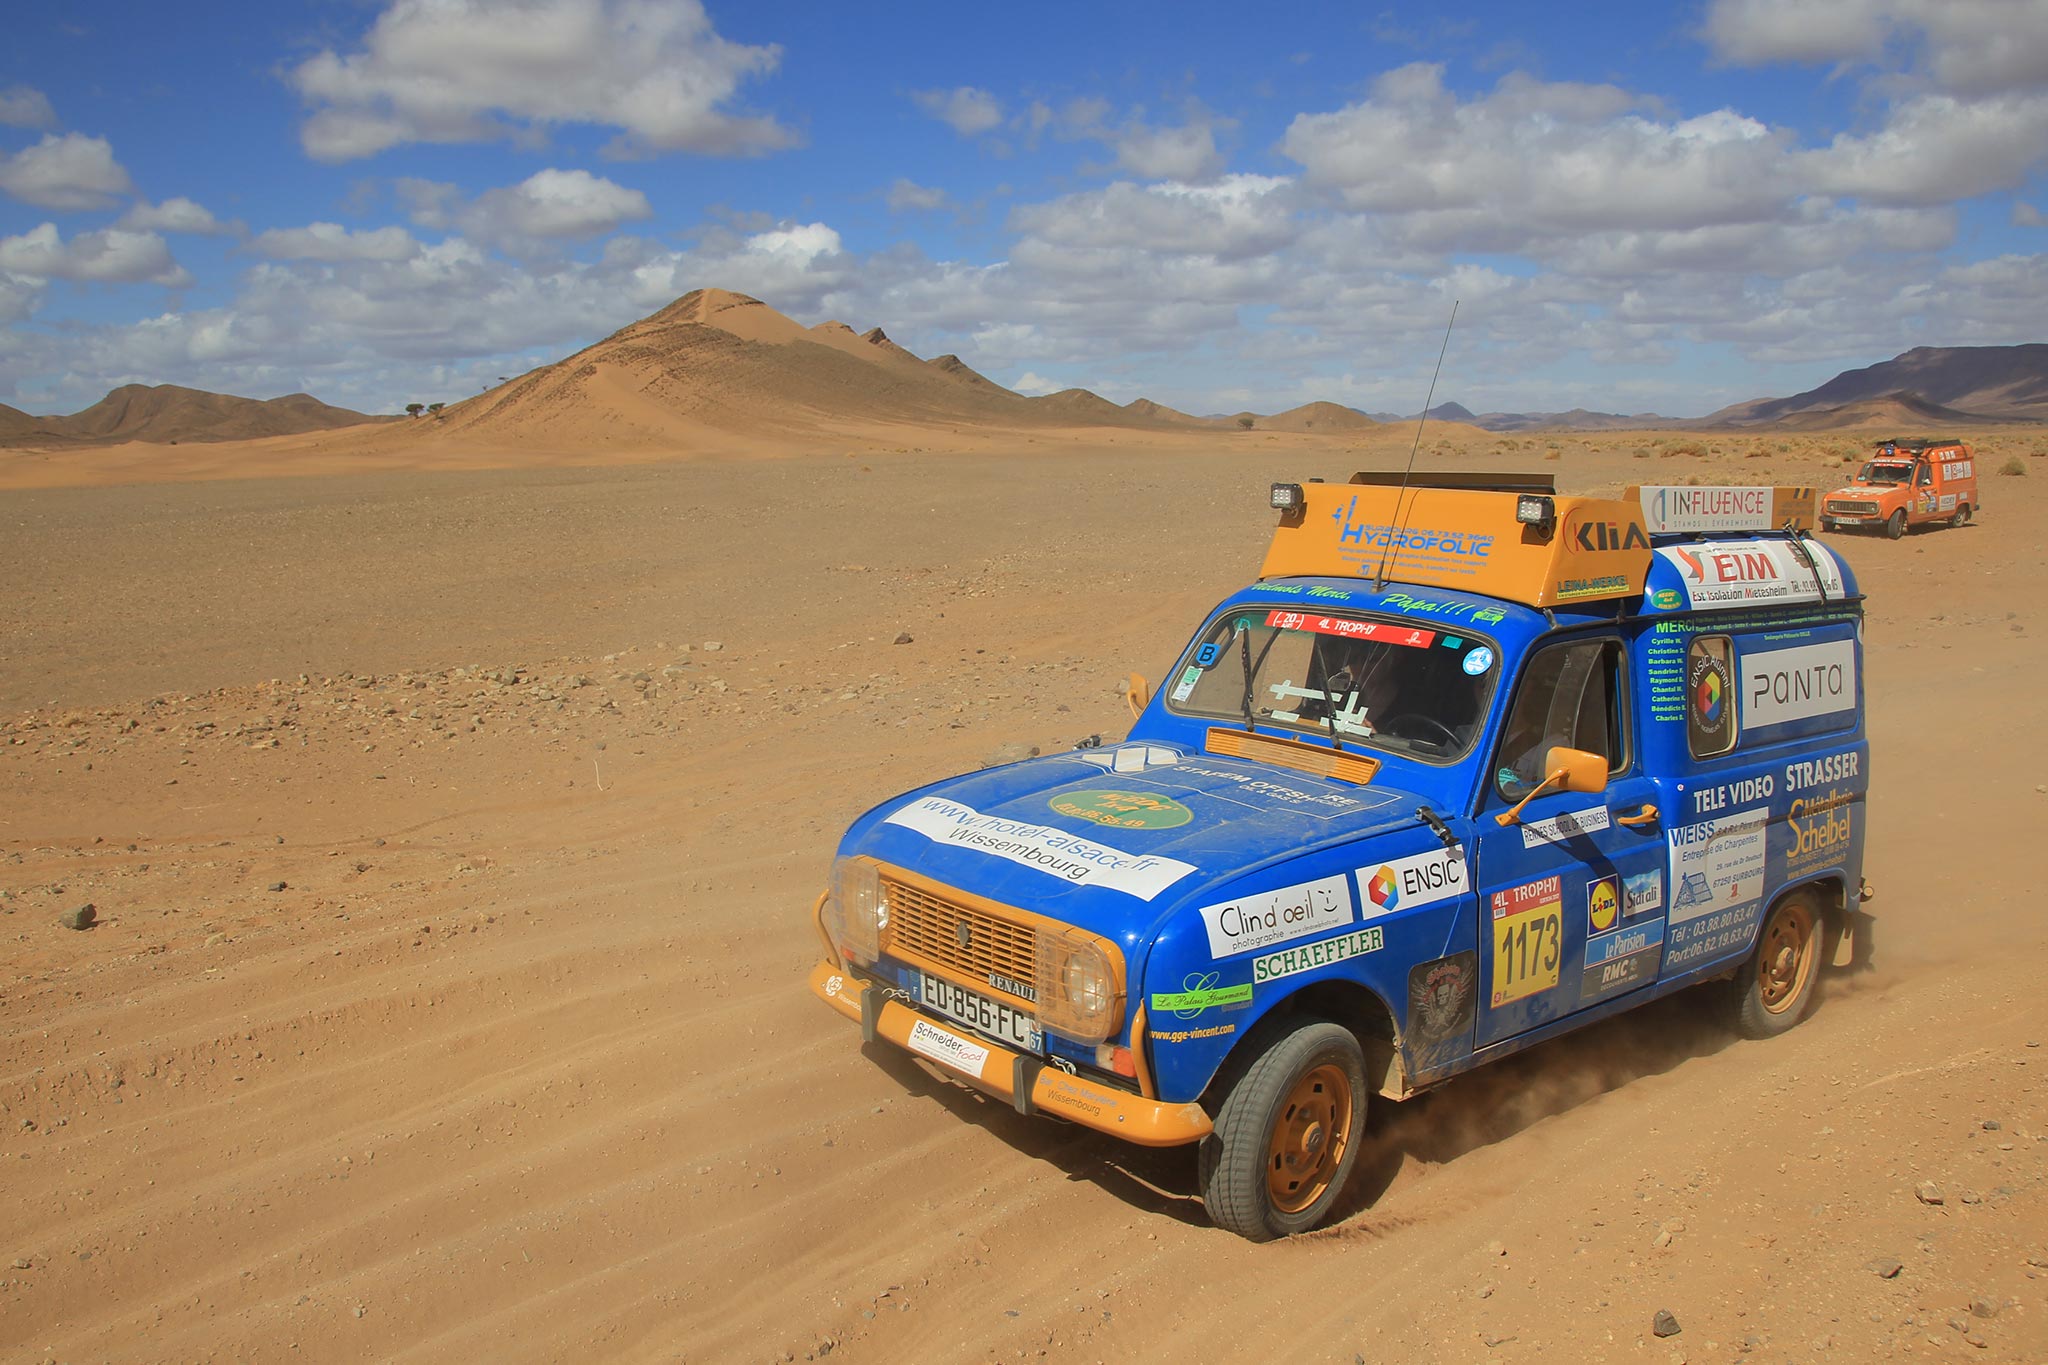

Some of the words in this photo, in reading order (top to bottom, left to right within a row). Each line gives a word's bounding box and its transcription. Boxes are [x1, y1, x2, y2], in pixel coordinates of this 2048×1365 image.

[1673, 491, 1764, 515] INFLUENCE
[1340, 523, 1492, 557] HYDROFOLIC
[1711, 553, 1778, 583] EIM
[1380, 594, 1476, 615] Papa!!!
[1707, 587, 1742, 601] Isolation
[1744, 585, 1788, 599] Mietesheim
[1318, 619, 1330, 629] 4L
[1334, 621, 1377, 635] TROPHY
[1656, 620, 1695, 634] MERCI
[1198, 645, 1216, 662] B
[1691, 655, 1710, 688] ENSIC
[1693, 788, 1726, 813] TELE
[1728, 774, 1774, 805] VIDEO
[1785, 751, 1859, 793] STRASSER
[921, 799, 1160, 872] www.hotel-alsace.fr
[1523, 823, 1548, 843] RENNES
[1548, 814, 1572, 838] SCHOOL
[1571, 815, 1580, 831] OF
[1579, 810, 1608, 830] BUSINESS
[1670, 821, 1715, 848] WEISS
[1786, 798, 1851, 858] Scheibel
[948, 826, 1092, 881] Wissembourg
[1682, 846, 1713, 862] Entreprise
[1403, 857, 1460, 896] ENSIC
[1494, 891, 1509, 908] 4L
[1513, 876, 1558, 902] TROPHY
[1626, 889, 1646, 910] Sidi
[1232, 929, 1285, 952] photographie
[1502, 913, 1559, 985] 1173
[1614, 931, 1646, 957] Parisien
[1671, 926, 1686, 945] Tél
[1256, 929, 1383, 981] SCHAEFFLER
[1602, 959, 1629, 984] RMC
[912, 986, 918, 995] F
[989, 973, 1036, 1001] RENAUL
[1173, 995, 1203, 1007] Palais
[1205, 986, 1251, 1005] Gourmand
[915, 1022, 963, 1051] Schneider
[1030, 1032, 1042, 1050] 67
[1047, 1088, 1101, 1117] Wissembourg
